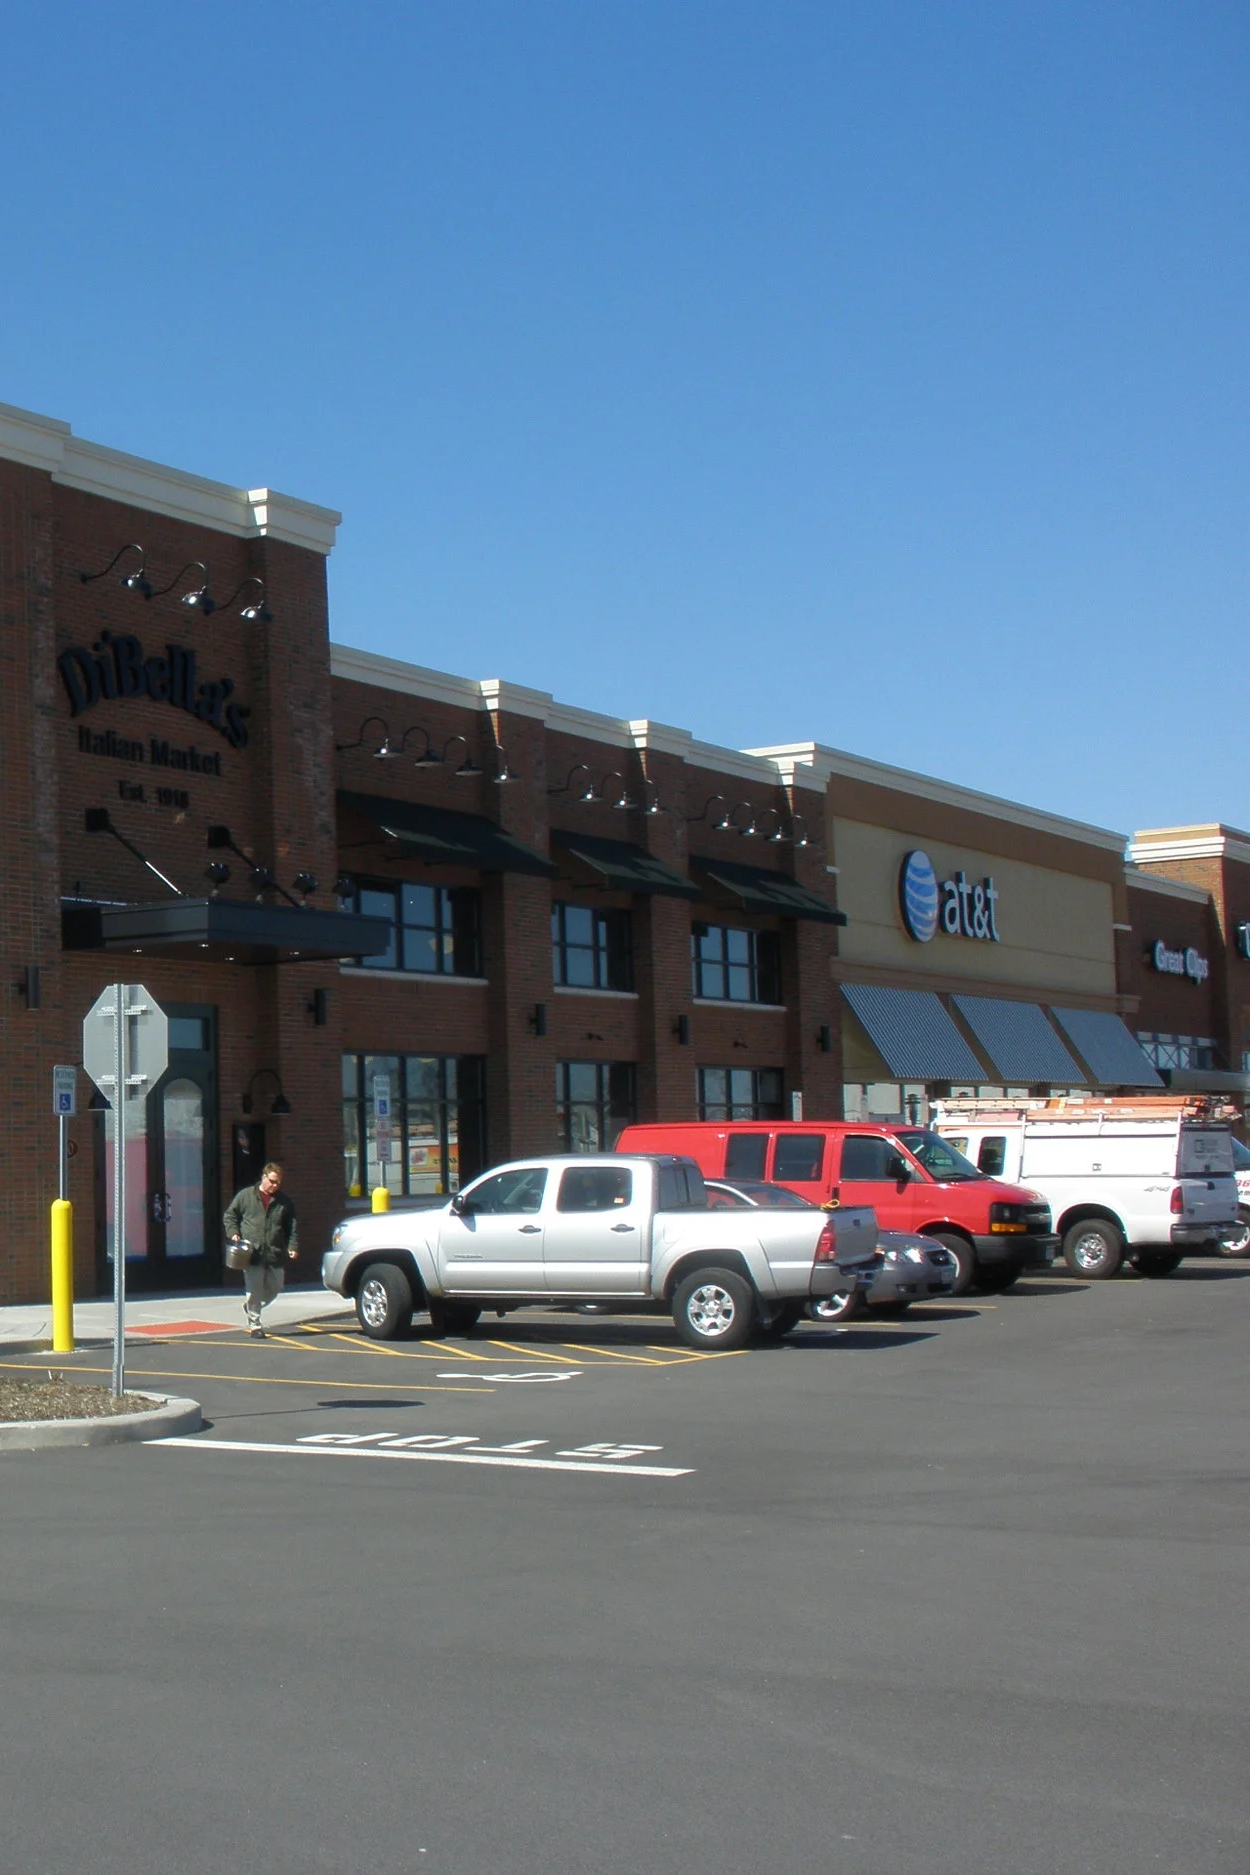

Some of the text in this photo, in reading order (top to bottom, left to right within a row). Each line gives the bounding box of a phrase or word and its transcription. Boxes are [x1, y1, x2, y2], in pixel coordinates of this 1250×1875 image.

[57, 630, 251, 748] DiBella's
[78, 725, 222, 776] Italian Market
[941, 871, 1000, 941] at&t
[1154, 940, 1209, 985] Great Clips
